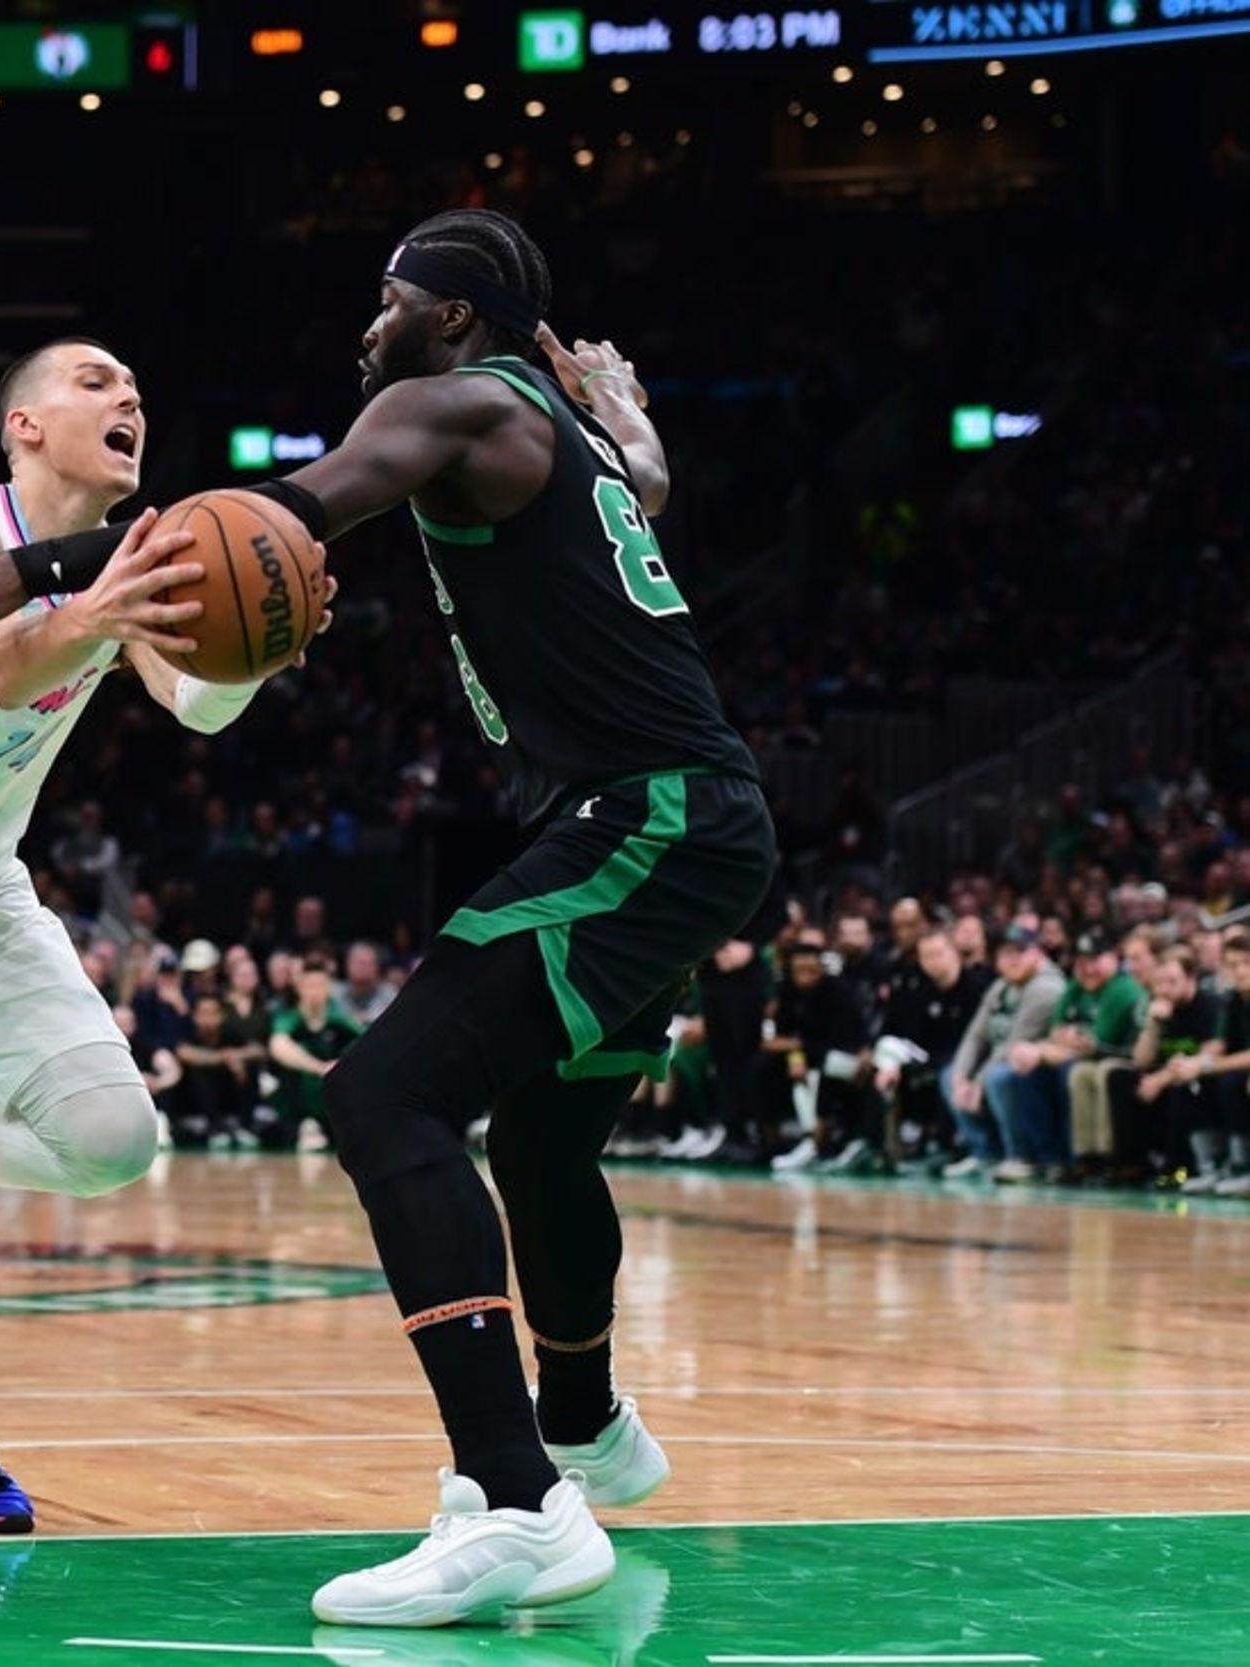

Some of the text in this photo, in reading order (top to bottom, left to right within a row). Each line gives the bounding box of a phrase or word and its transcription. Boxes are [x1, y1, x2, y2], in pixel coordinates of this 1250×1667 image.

[590, 18, 670, 54] Bank
[781, 9, 841, 48] PM
[251, 533, 292, 665] Wilson
